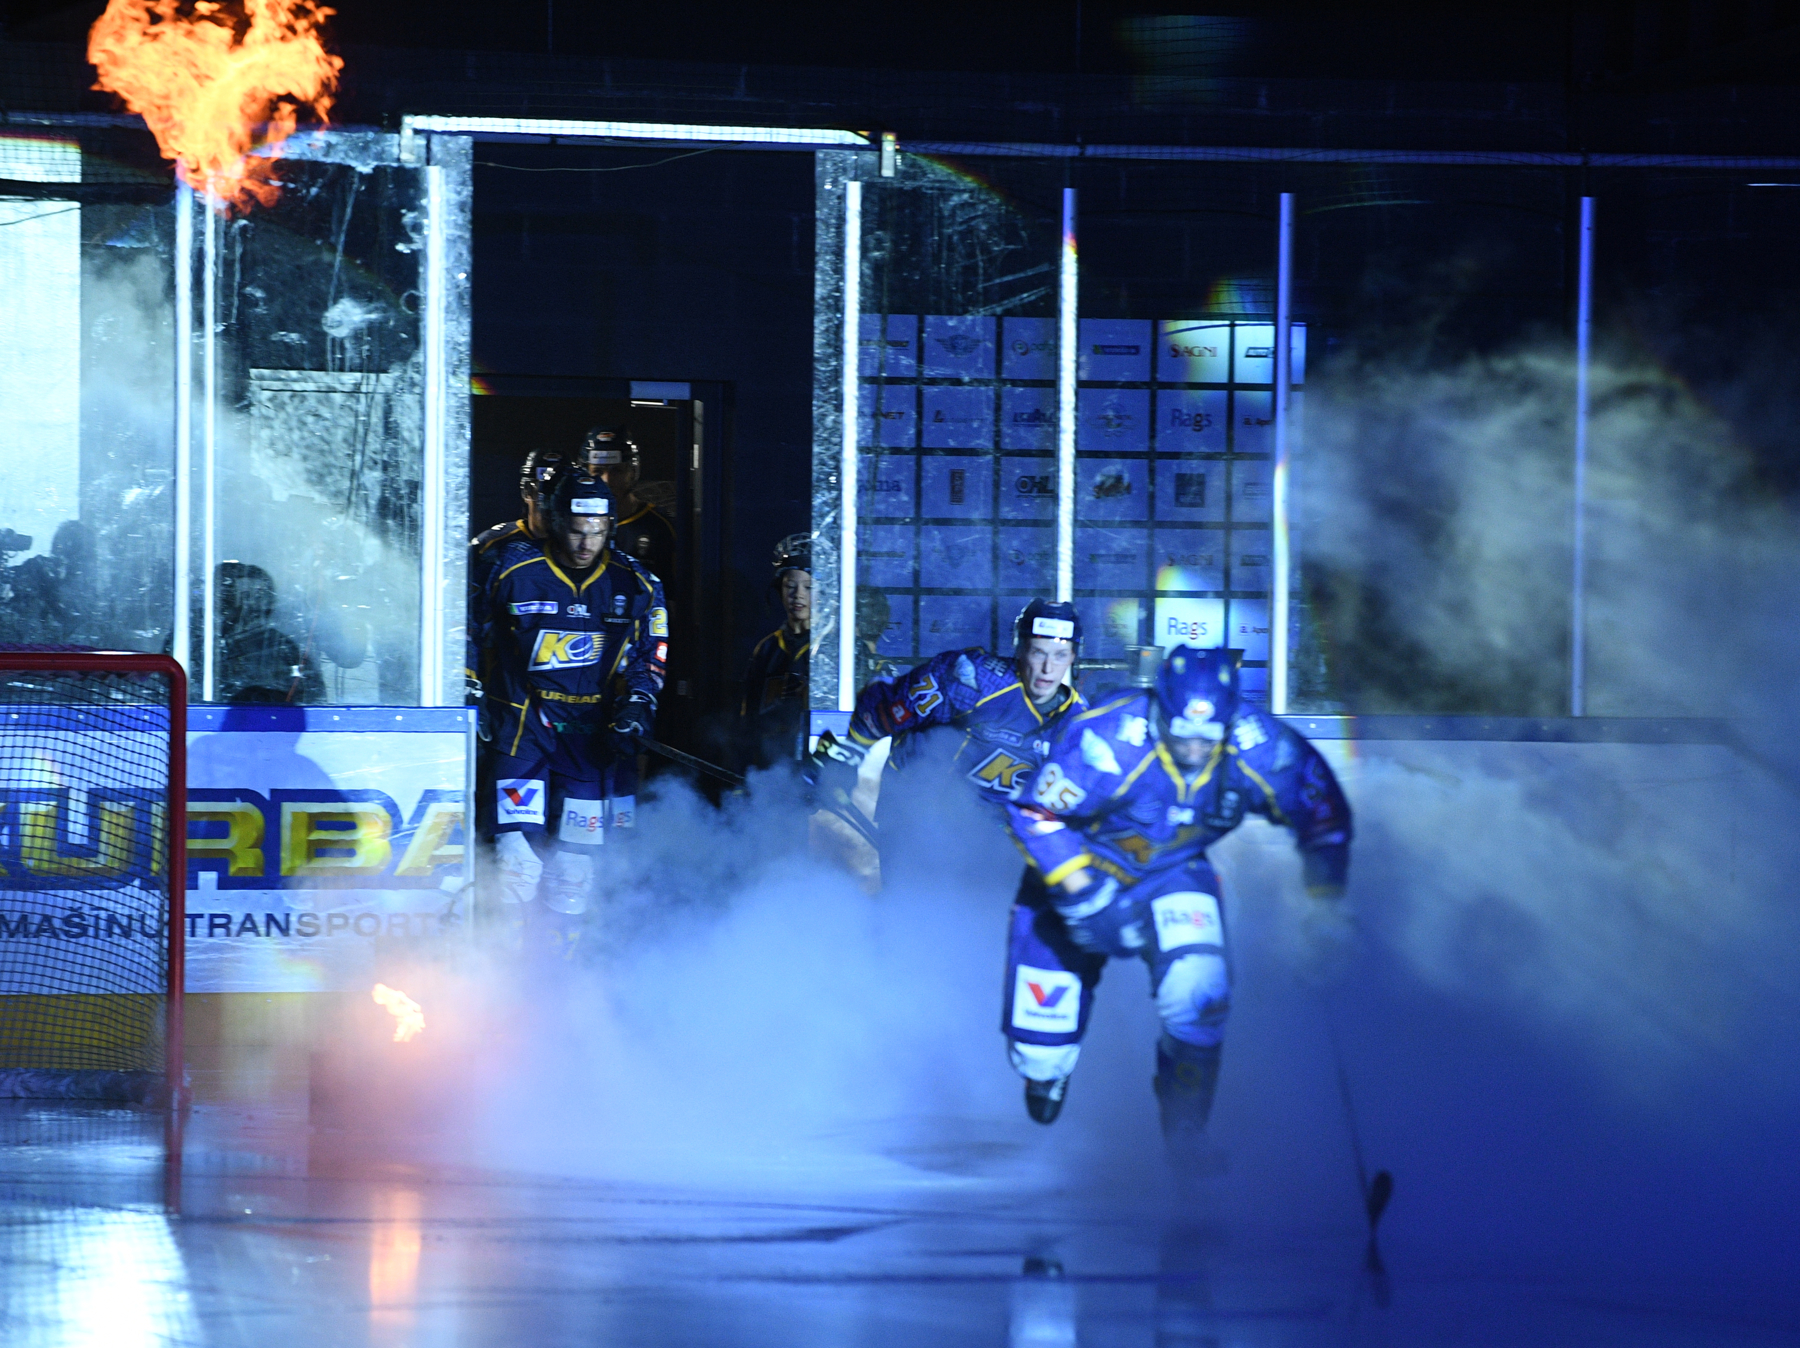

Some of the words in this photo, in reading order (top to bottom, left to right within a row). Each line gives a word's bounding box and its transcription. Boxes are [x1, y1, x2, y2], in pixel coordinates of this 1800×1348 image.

[1171, 409, 1212, 432] Rags
[1167, 617, 1208, 640] Rags
[908, 674, 943, 717] 71
[184, 911, 462, 938] TRANSPORTS
